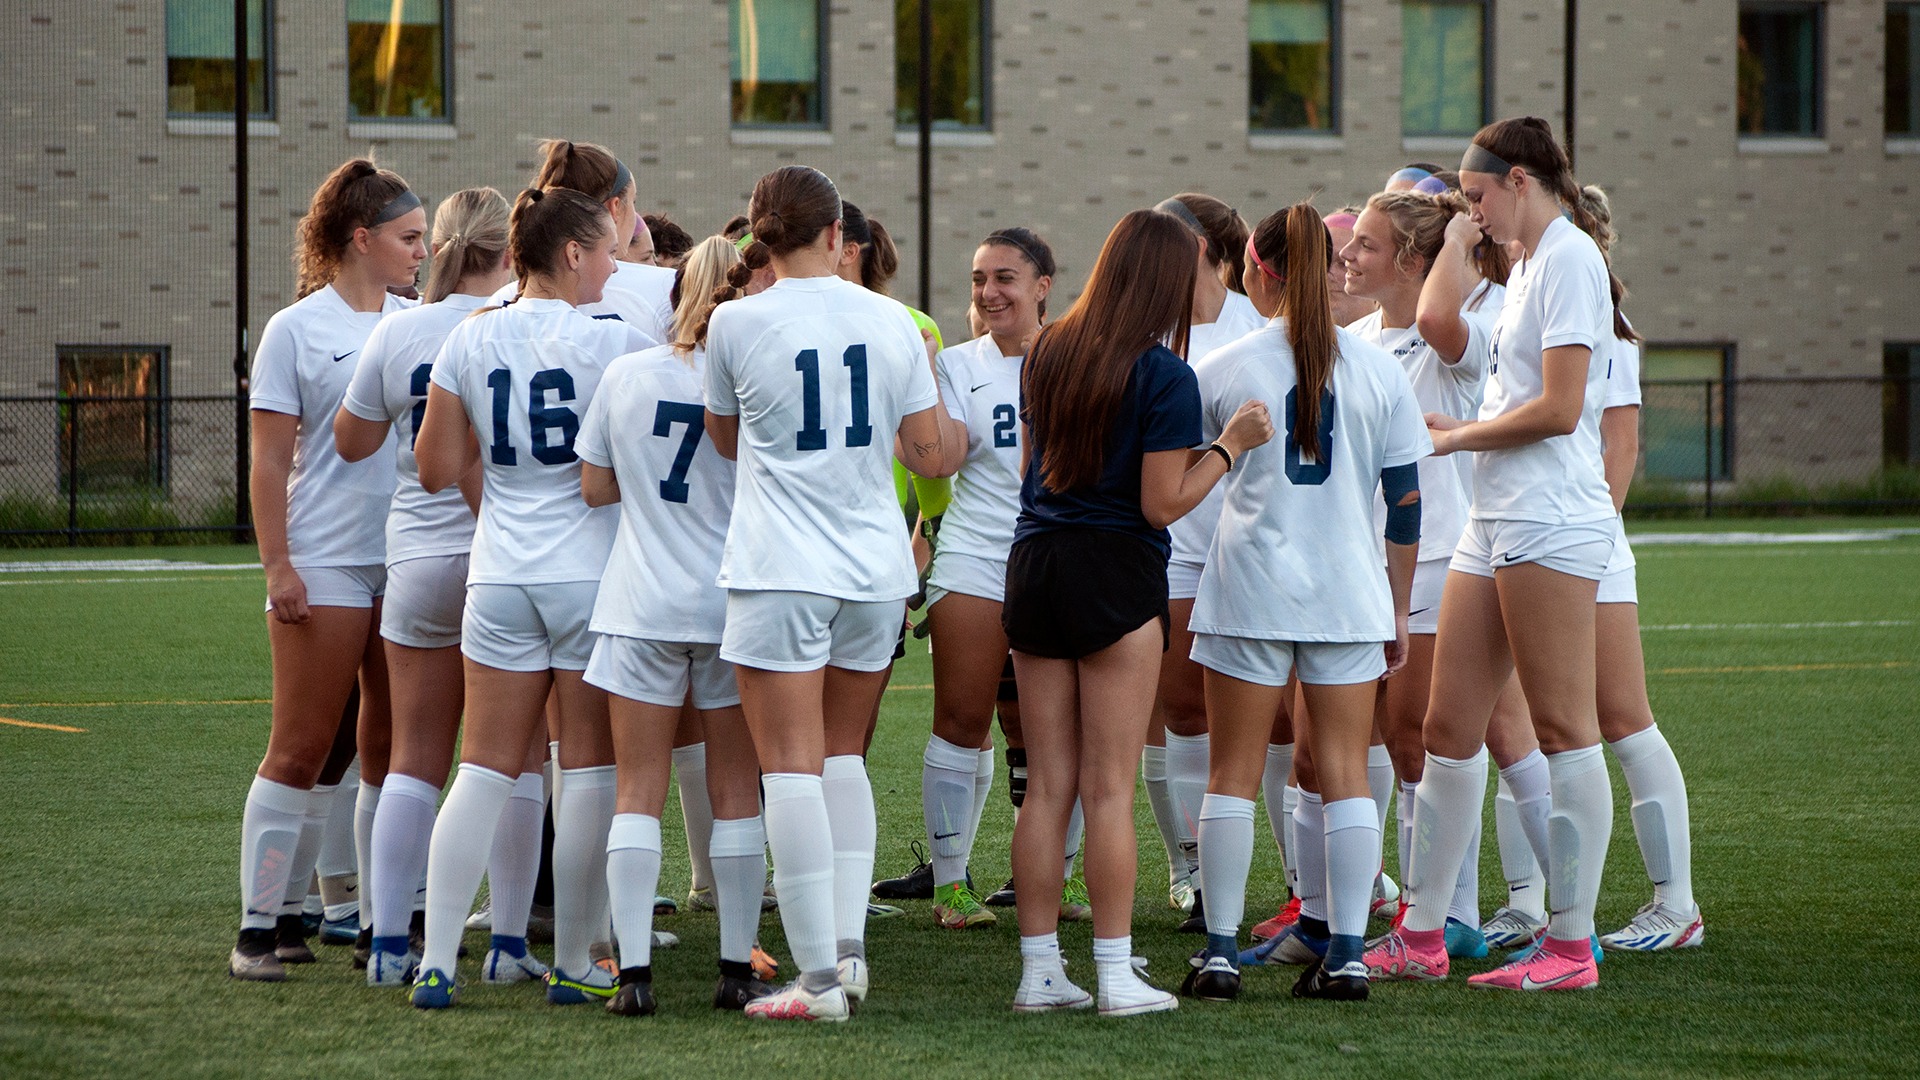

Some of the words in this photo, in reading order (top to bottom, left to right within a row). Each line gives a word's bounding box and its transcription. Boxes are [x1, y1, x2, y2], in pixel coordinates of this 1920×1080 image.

[488, 368, 580, 466] 16
[795, 343, 872, 450] 11
[993, 404, 1017, 448] 2
[1285, 384, 1334, 485] 8
[653, 400, 705, 504] 7
